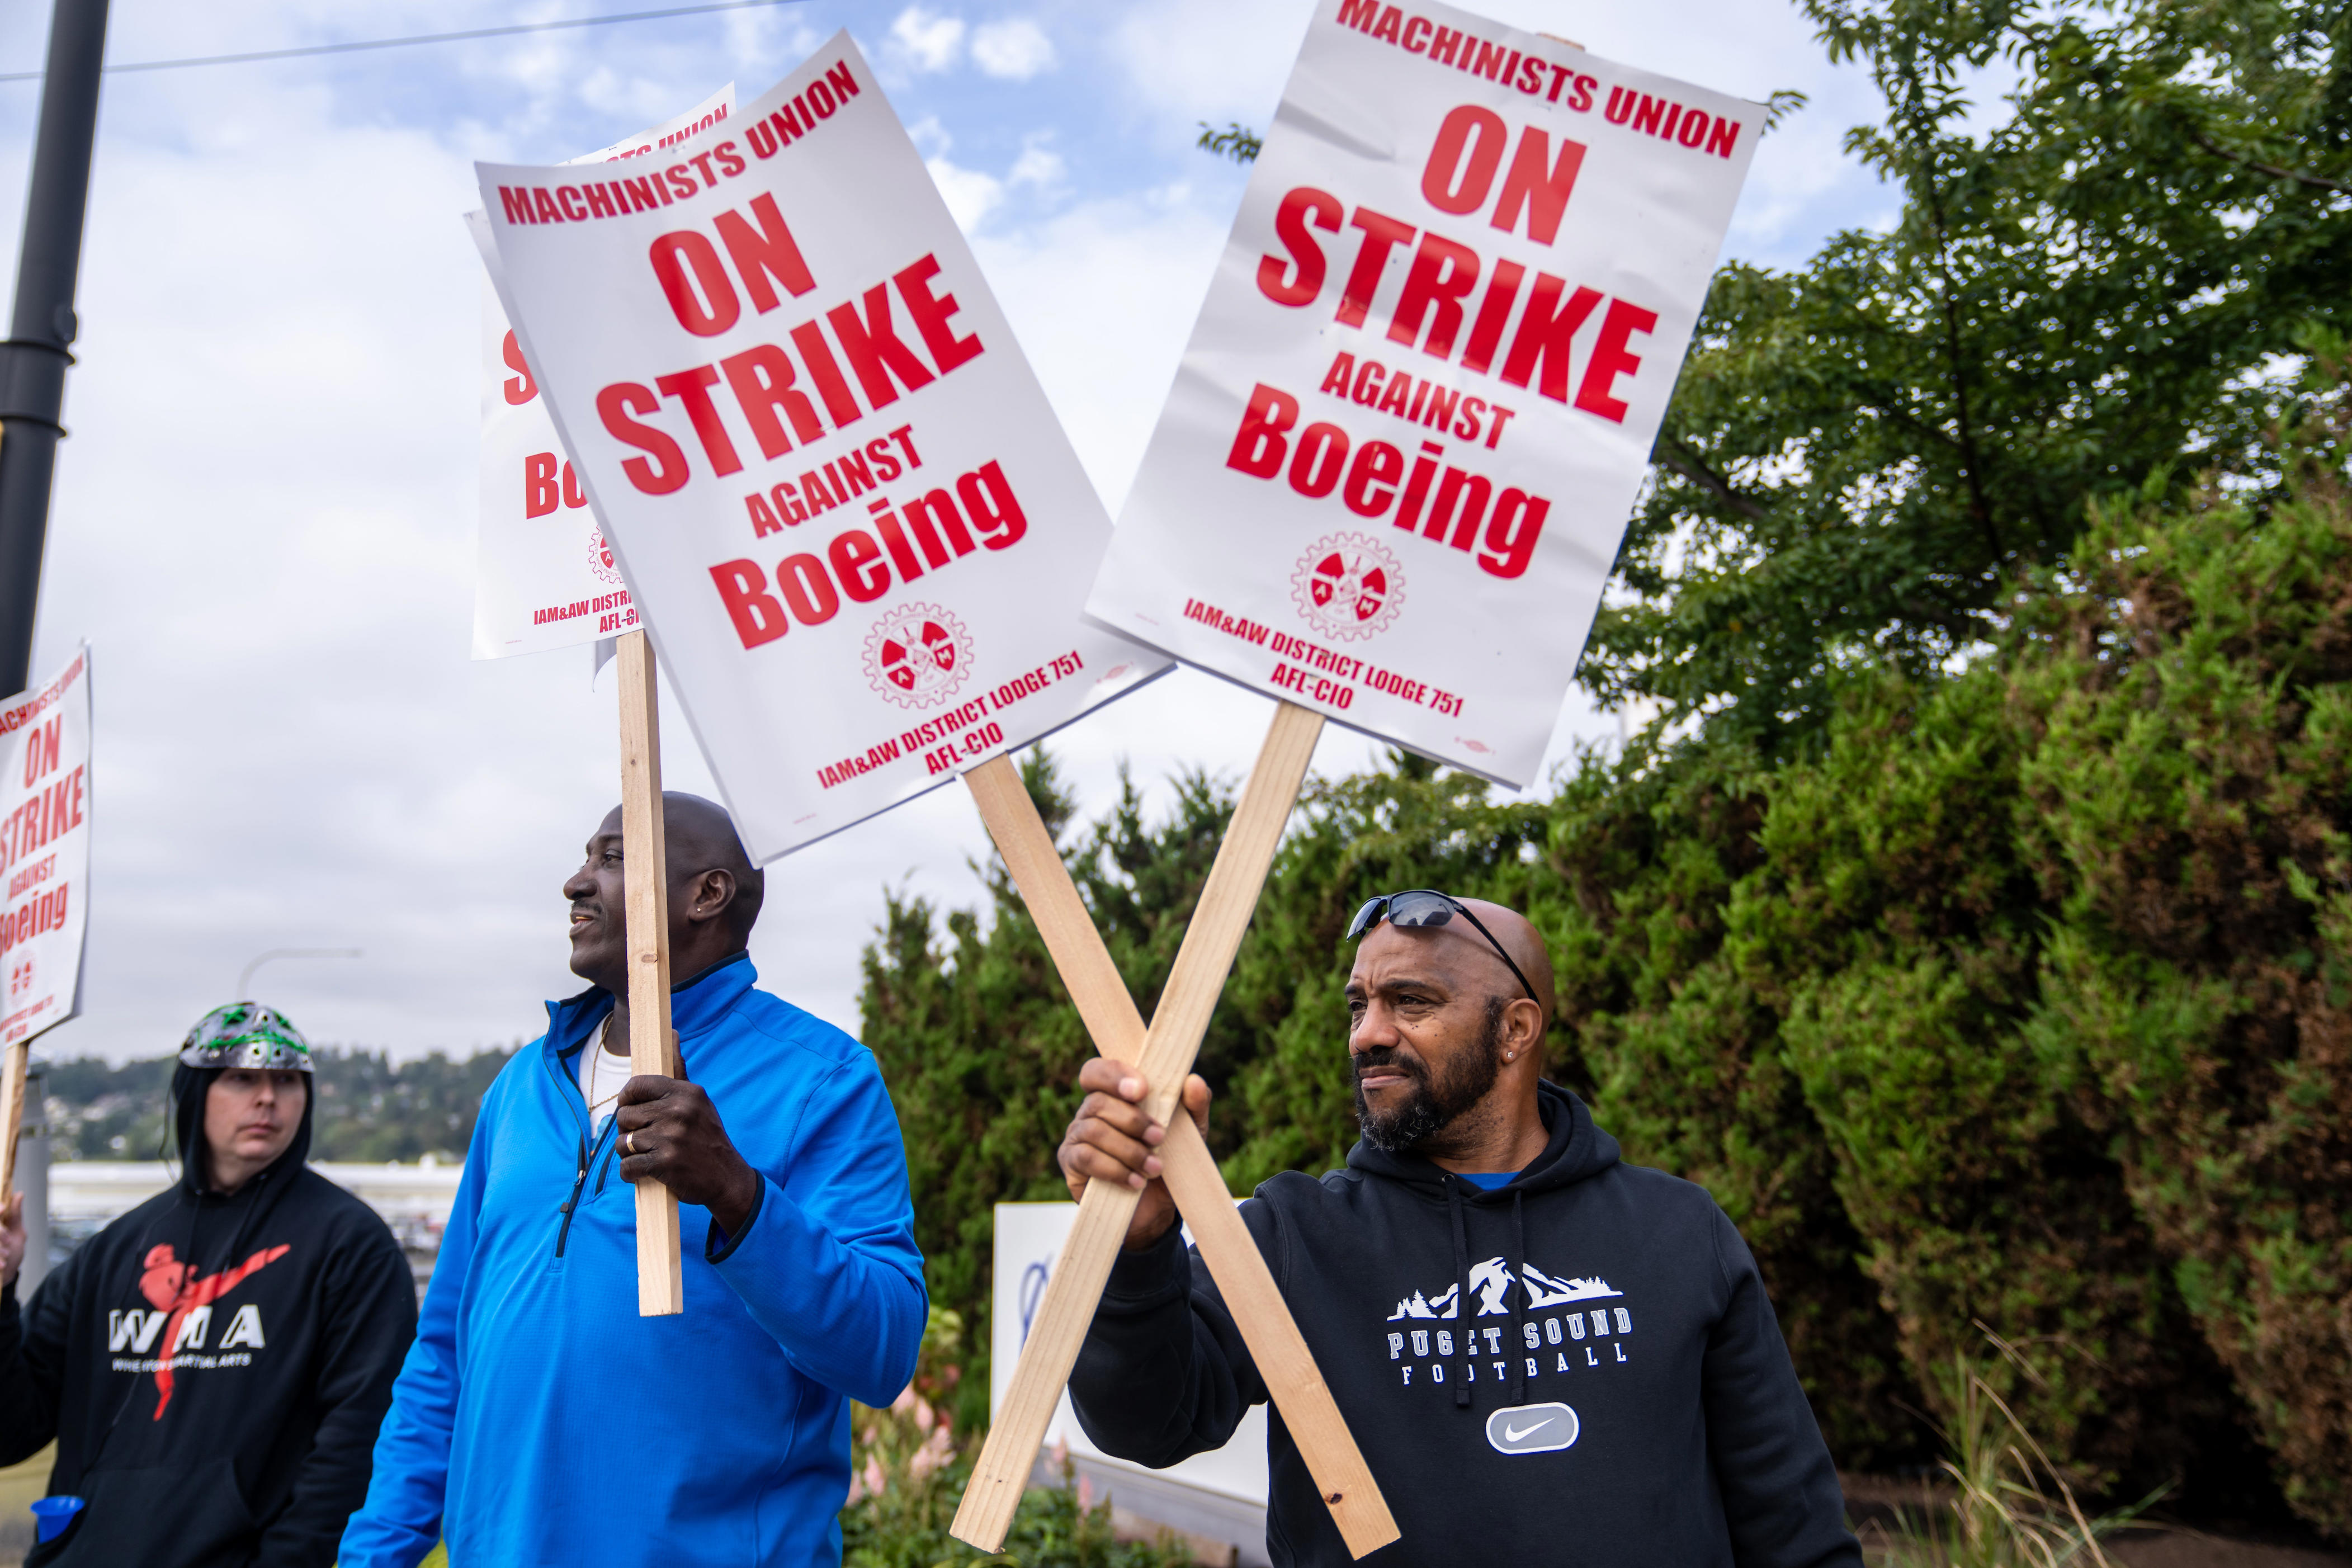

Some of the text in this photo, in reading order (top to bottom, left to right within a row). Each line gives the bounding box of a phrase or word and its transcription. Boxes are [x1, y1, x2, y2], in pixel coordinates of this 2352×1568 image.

[1335, 0, 1741, 160] MACHINISTS UNION
[498, 60, 860, 225] MACHINISTS UNION
[1421, 105, 1587, 247] ON
[649, 191, 817, 338] ON
[1256, 186, 1659, 425] STRIKE
[596, 252, 985, 497] STRIKE
[1319, 351, 1516, 451] AGAINST
[744, 423, 923, 539] AGAINST
[1225, 382, 1552, 580] Boeing
[606, 552, 612, 561] A
[708, 459, 1028, 650] Boeing
[534, 599, 589, 625] IAM&AW
[599, 608, 639, 634] AFL-CI
[1183, 598, 1464, 717] IAM&AW DISTRICT LODGE 751
[817, 650, 1084, 789] IAM&AW DISTRICT LODGE 751
[1270, 662, 1354, 710] AFL-CIO
[25, 712, 61, 789] ON
[924, 721, 1004, 776] AFL-CIO
[0, 764, 83, 877] STRIKE
[0, 882, 68, 957] oeing
[218, 1352, 252, 1368] ARTS
[1523, 1307, 1632, 1349] SOUND
